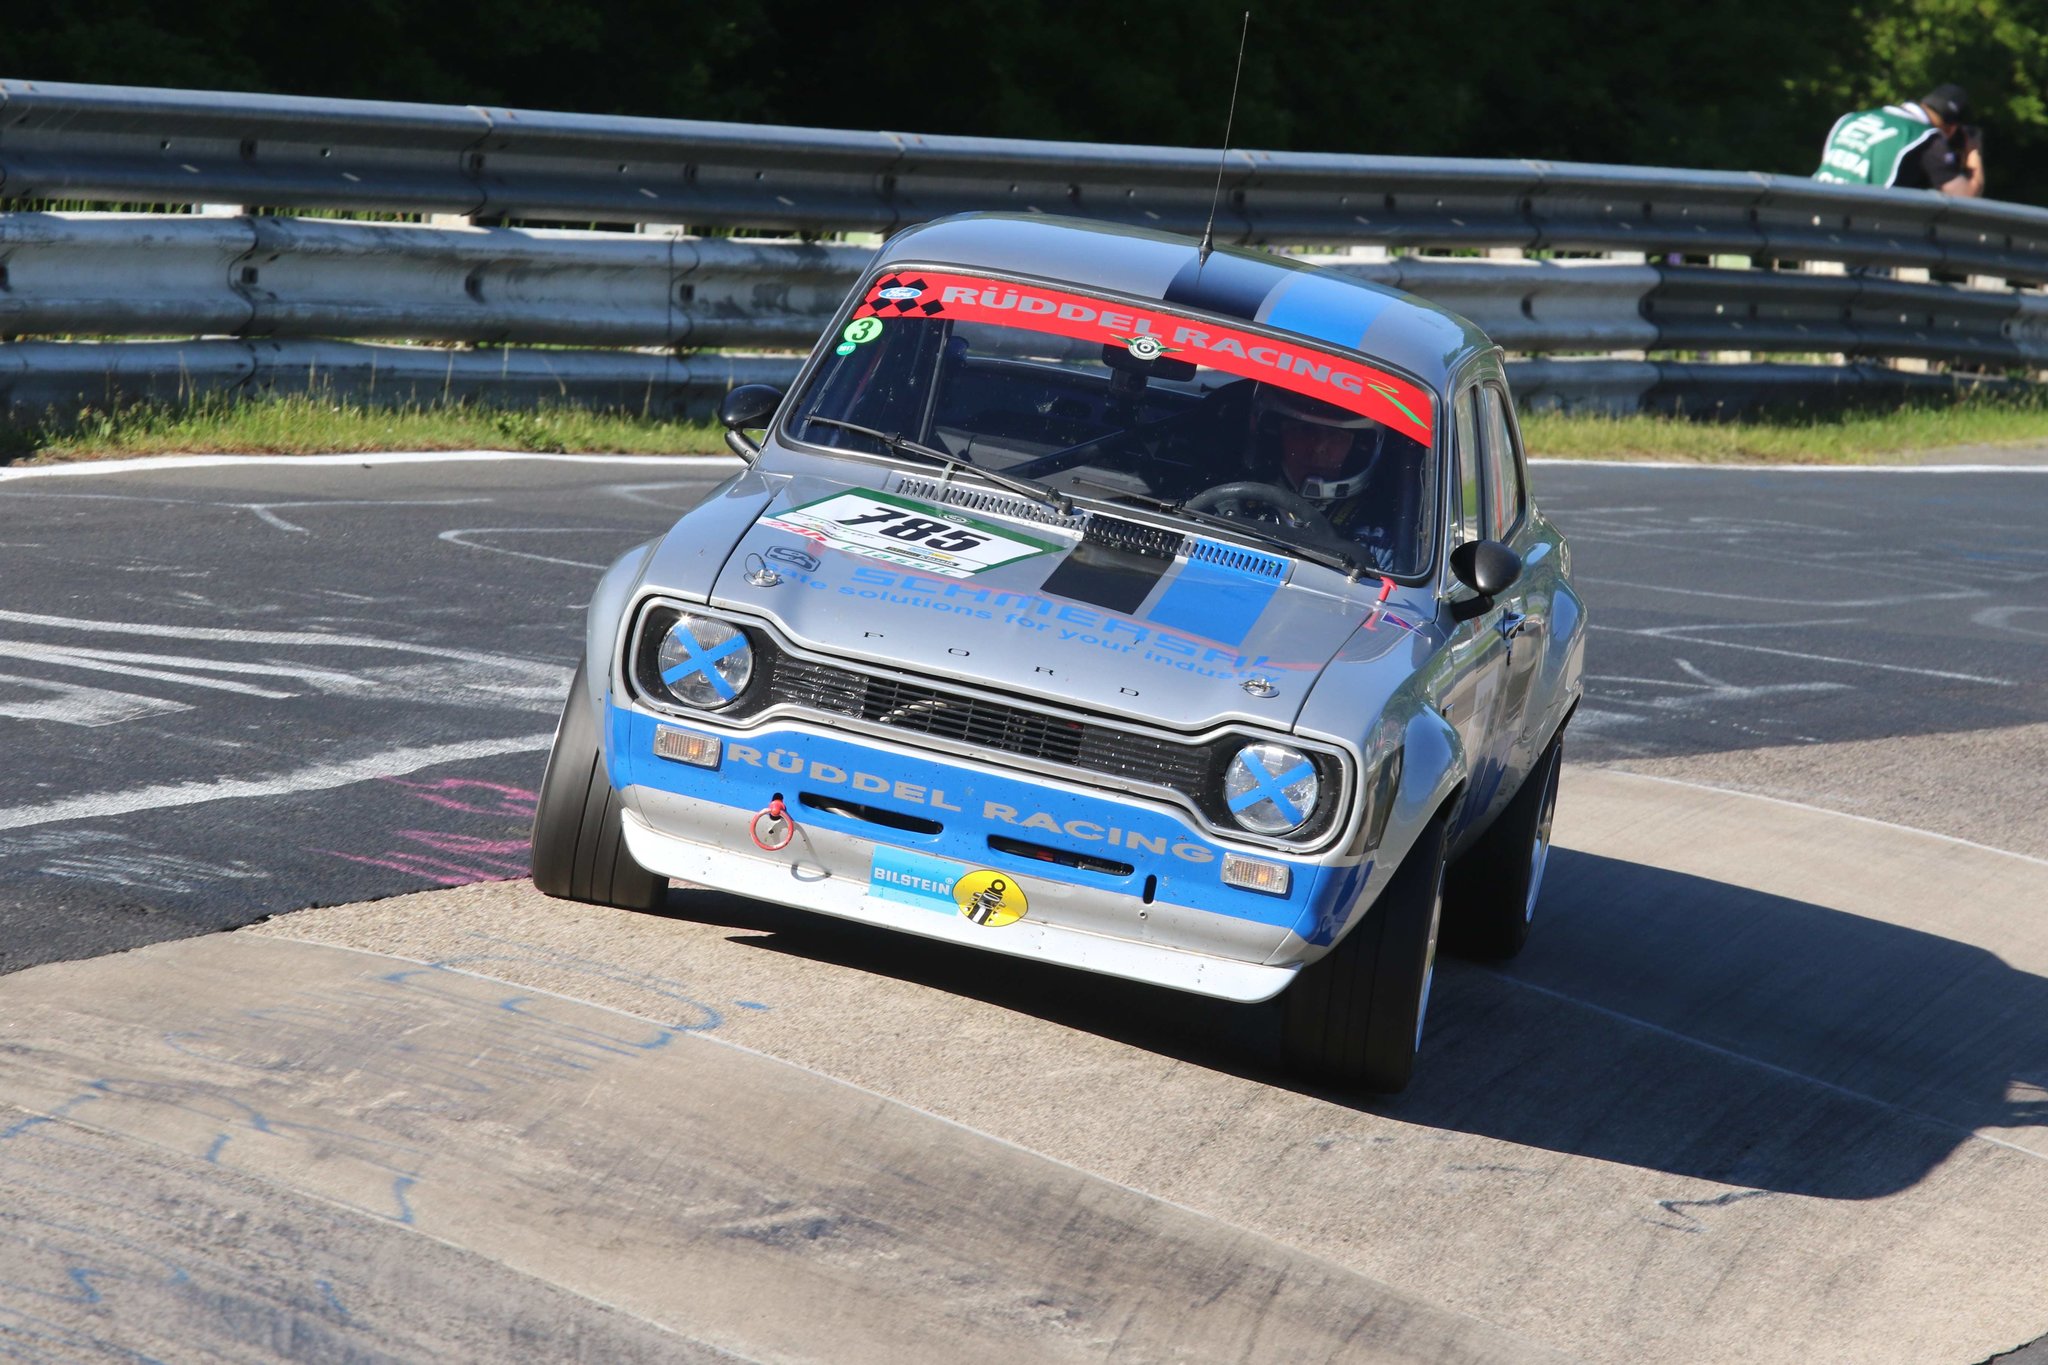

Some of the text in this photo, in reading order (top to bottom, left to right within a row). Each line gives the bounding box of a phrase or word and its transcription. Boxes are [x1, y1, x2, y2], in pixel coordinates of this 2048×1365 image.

[885, 289, 914, 298] Ford
[852, 320, 873, 340] 3
[941, 285, 1162, 339] RÜDDEL
[1172, 326, 1363, 396] RACING
[834, 507, 992, 551] 785
[841, 545, 959, 575] Classic
[837, 585, 992, 620] solutions
[1004, 612, 1051, 633] for
[1059, 628, 1138, 656] your
[851, 566, 1287, 673] SCHMERSAL
[727, 742, 1215, 864] RÜDDEL RACING
[874, 867, 950, 896] BILSTEIN
